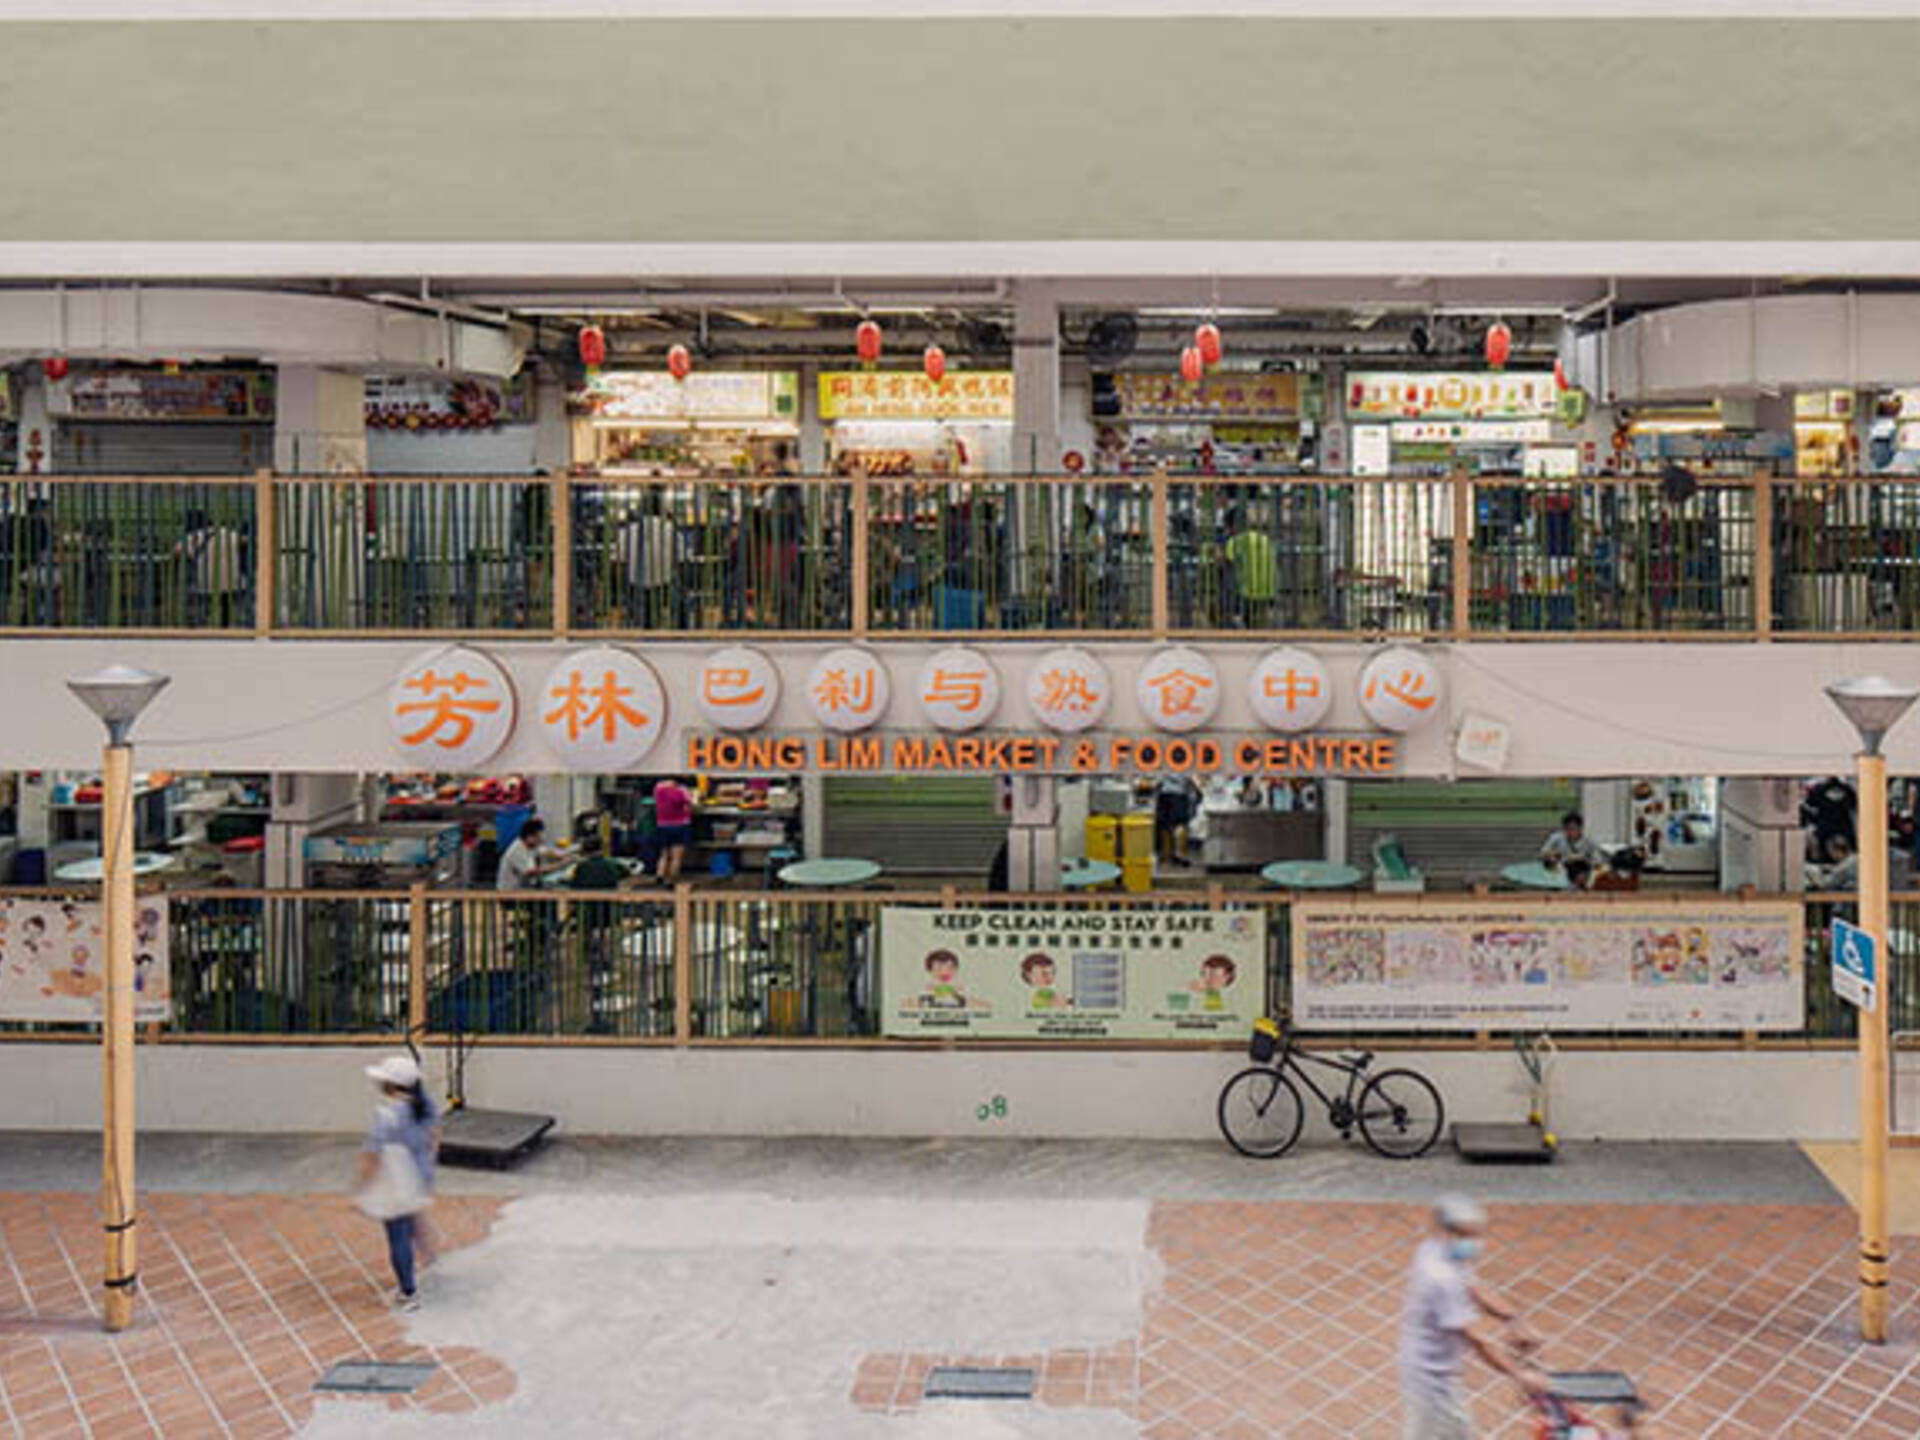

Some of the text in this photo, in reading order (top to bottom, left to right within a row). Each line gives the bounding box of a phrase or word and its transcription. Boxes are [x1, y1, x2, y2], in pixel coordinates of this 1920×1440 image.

[394, 667, 1438, 750] 芳林巴刹与熟食中心
[688, 736, 1396, 773] HONG LIM MARKET & FOOD CENTRE
[933, 913, 1214, 932] KEEP CLEAN AND STAY SAFE
